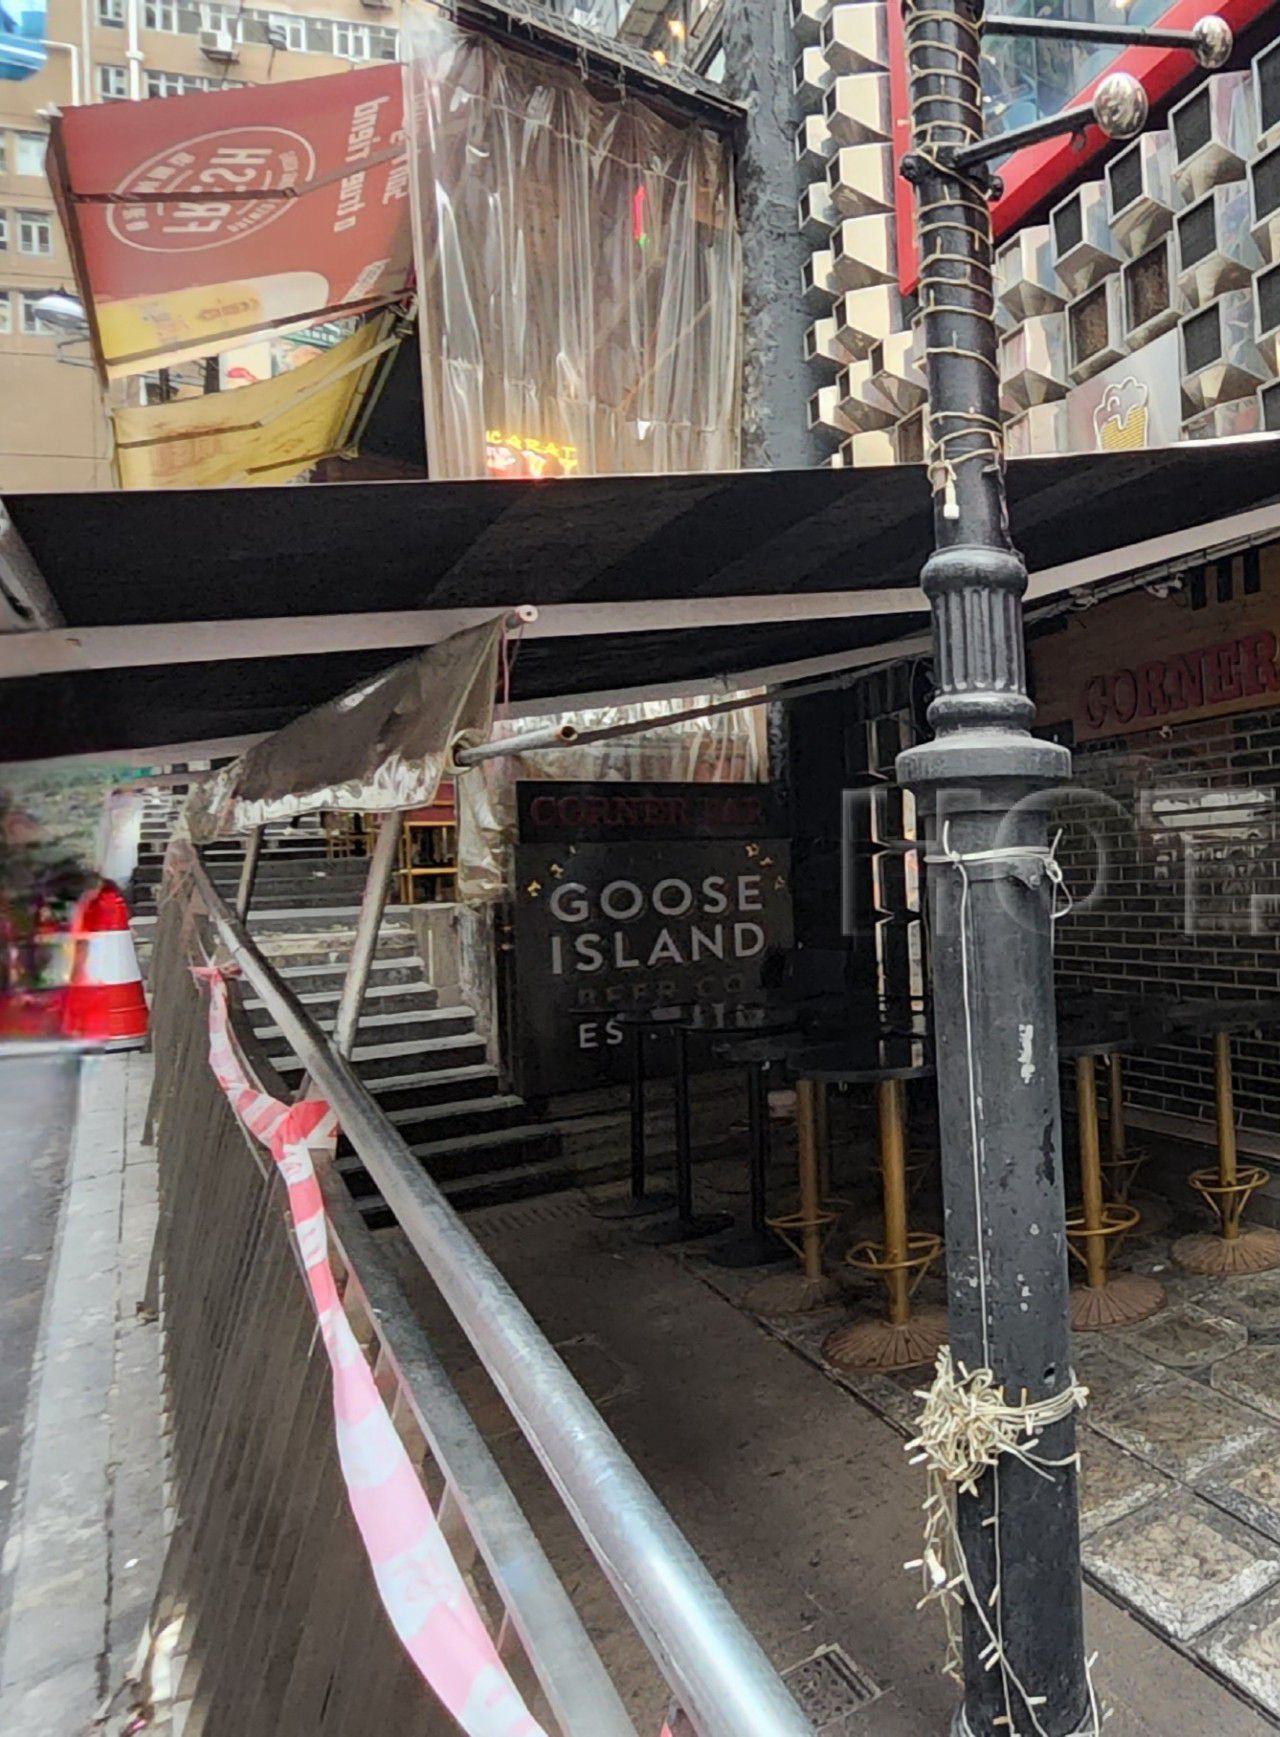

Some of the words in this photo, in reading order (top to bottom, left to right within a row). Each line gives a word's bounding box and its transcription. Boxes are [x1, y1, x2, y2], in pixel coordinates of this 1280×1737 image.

[530, 795, 689, 827] CORNER
[549, 875, 763, 923] GOOSE
[551, 922, 766, 975] ISLAND
